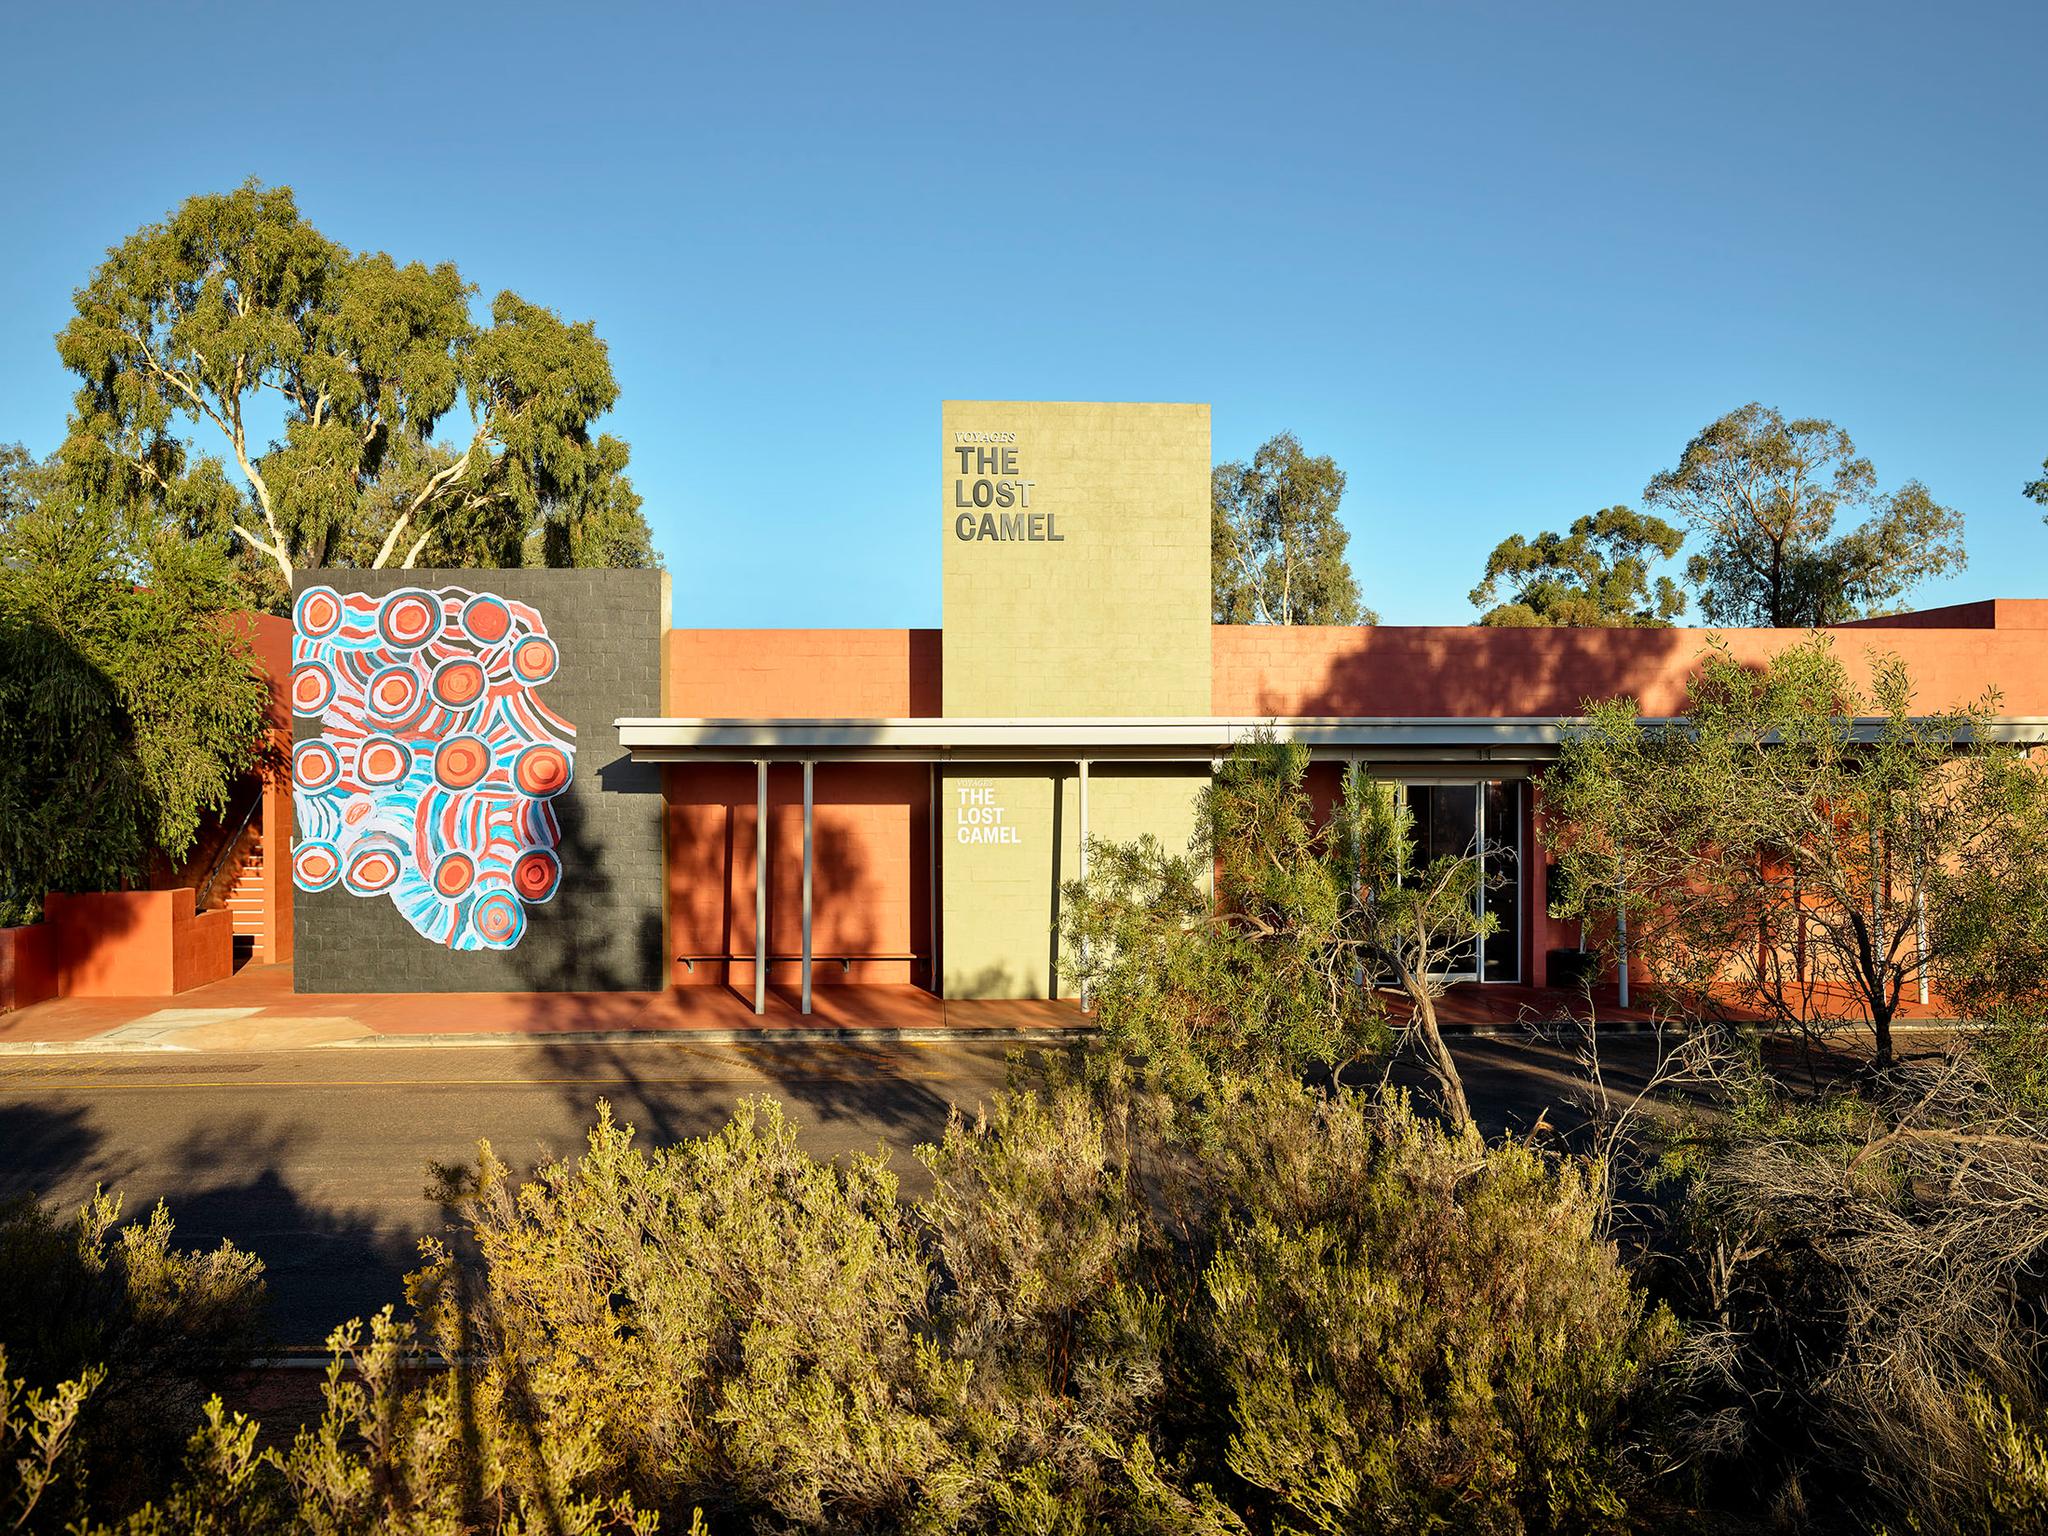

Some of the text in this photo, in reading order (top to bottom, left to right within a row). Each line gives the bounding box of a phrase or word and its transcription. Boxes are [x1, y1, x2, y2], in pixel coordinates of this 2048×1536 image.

[955, 432, 1016, 443] VOYAGES
[955, 446, 1019, 475] THE
[955, 479, 1035, 508] LOST
[955, 512, 1065, 542] CAMEL
[957, 788, 995, 805] THE
[957, 807, 1005, 825] LOST
[957, 826, 1022, 844] CAMEL
